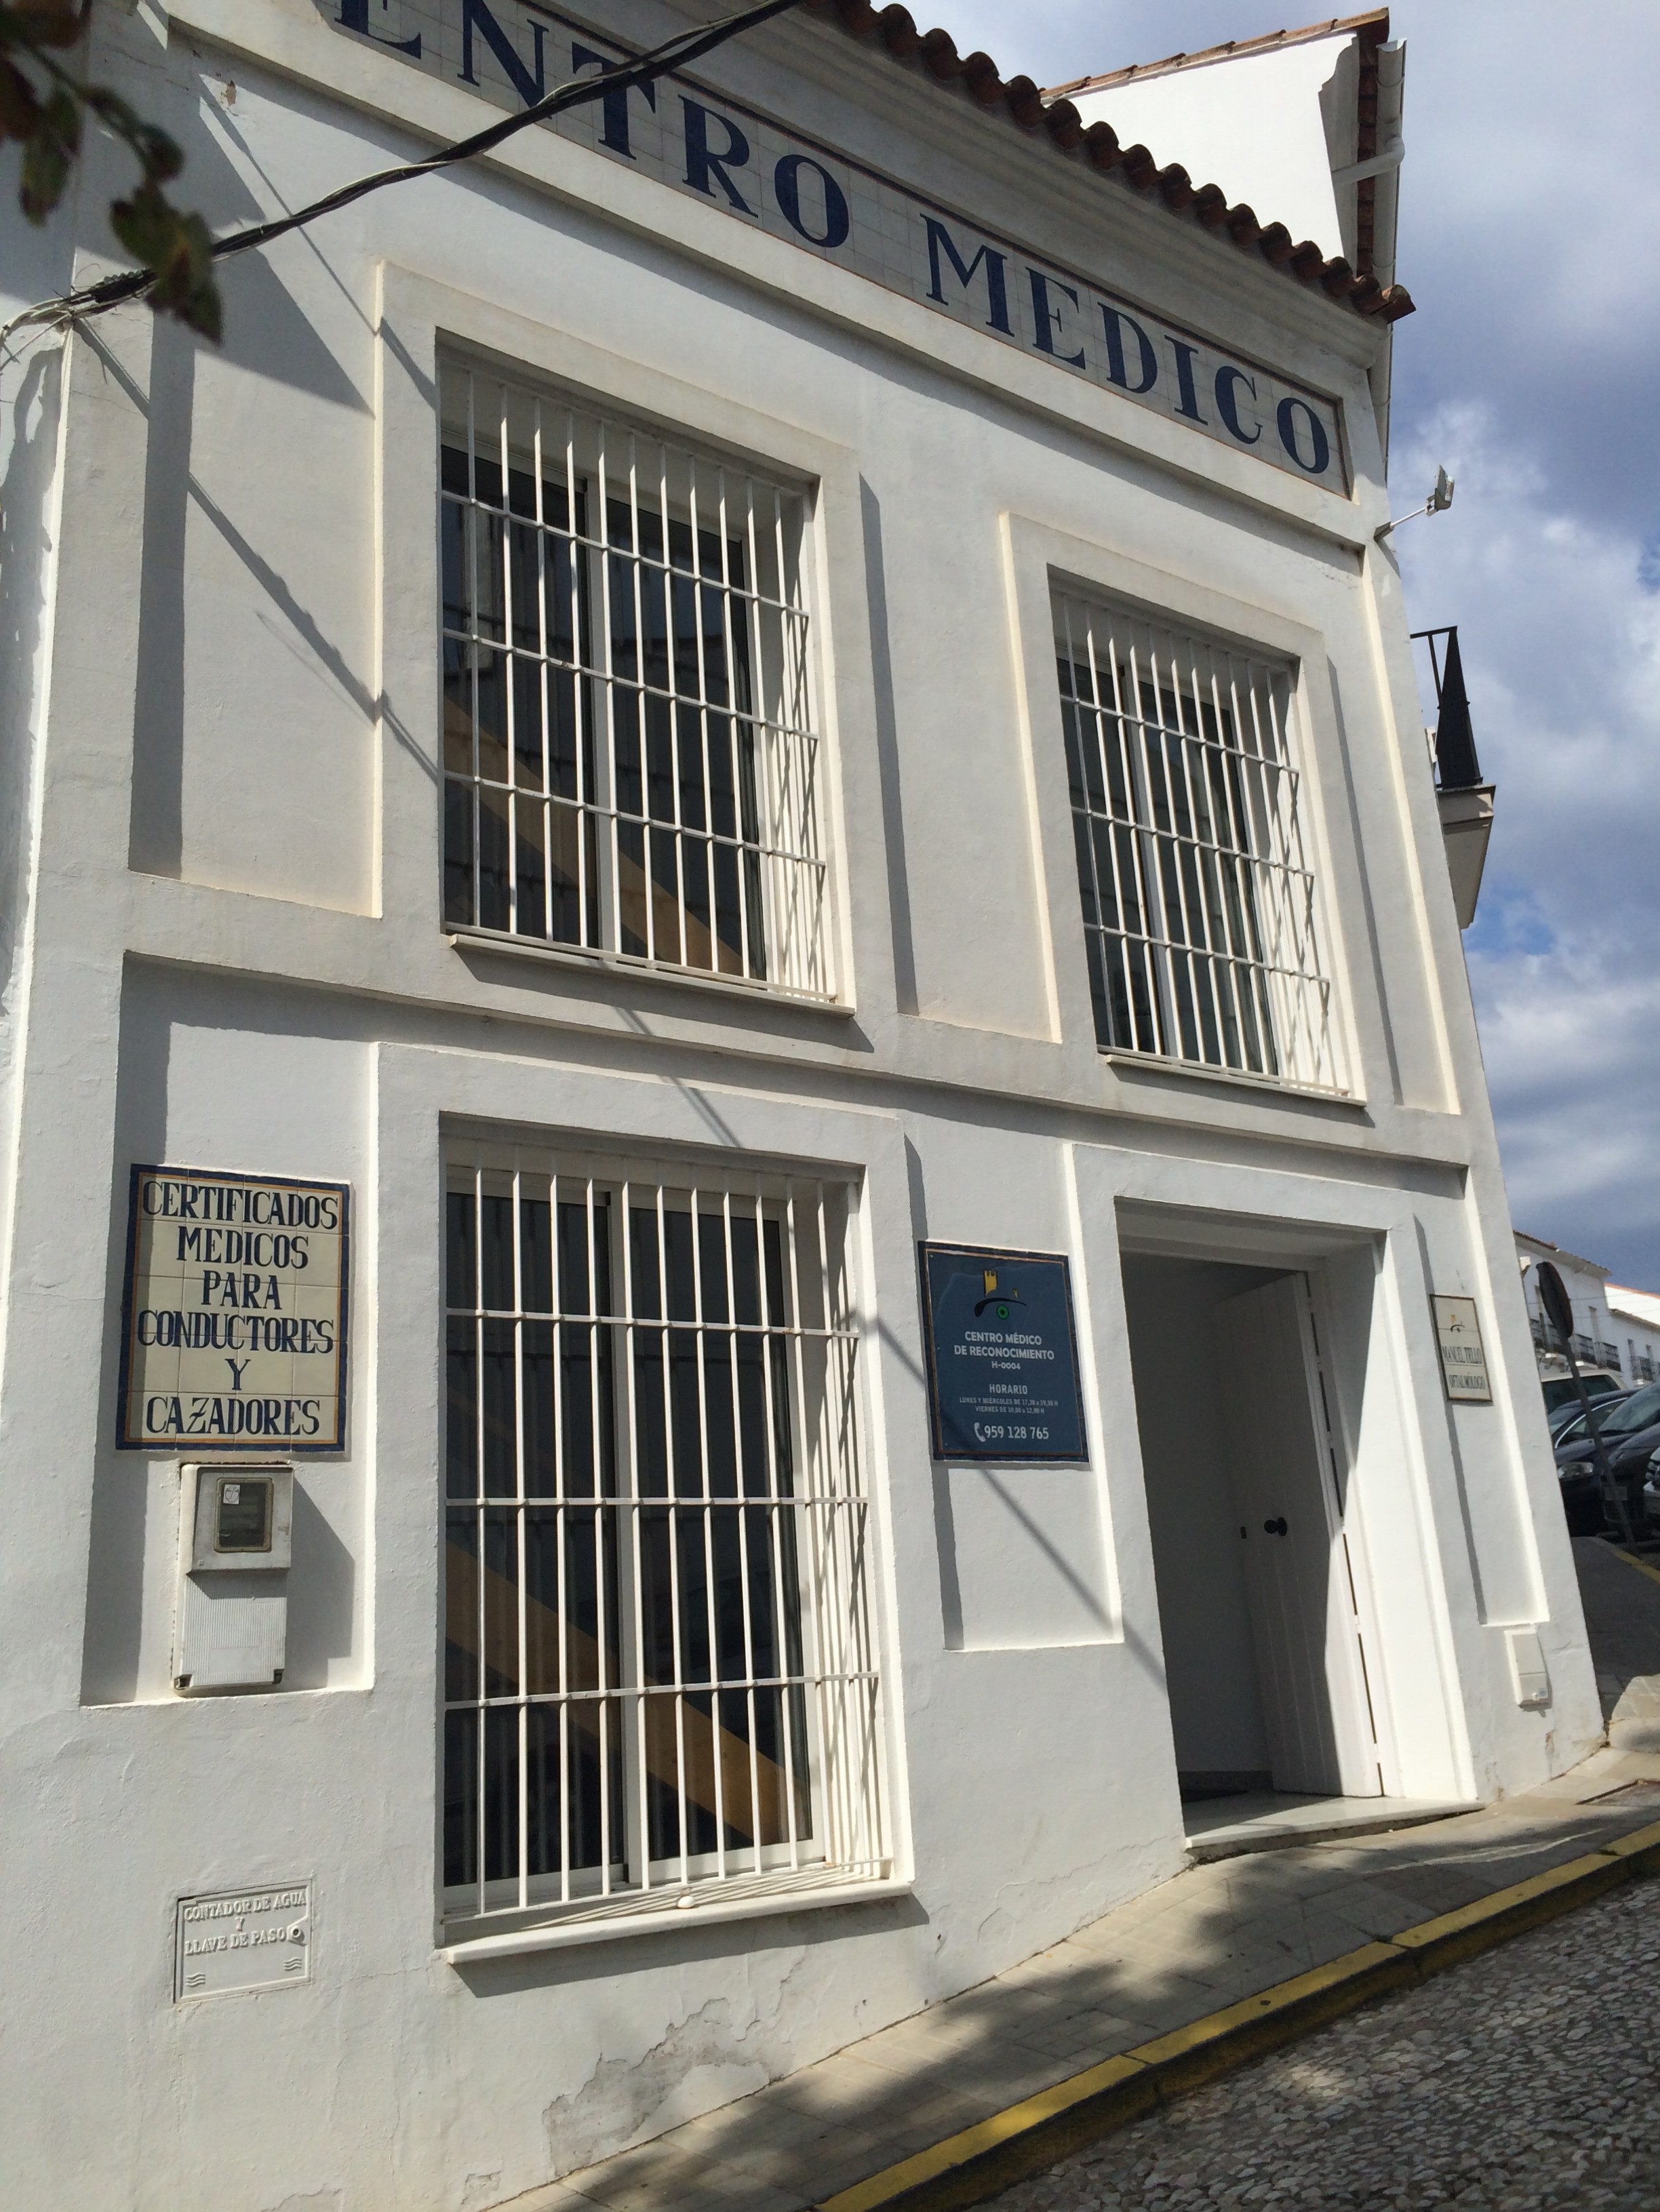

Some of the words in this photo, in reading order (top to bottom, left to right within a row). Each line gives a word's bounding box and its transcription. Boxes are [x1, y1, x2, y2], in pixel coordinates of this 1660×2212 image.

[919, 212, 1330, 474] MEDICO
[142, 1180, 338, 1230] CERTIFICADOS
[176, 1226, 309, 1269] MEDICOS
[201, 1270, 283, 1310] PARA
[138, 1310, 334, 1354] CONDUCTORES
[964, 1331, 1004, 1343] CENTRO
[1005, 1332, 1042, 1346] MÉDICO
[953, 1344, 967, 1355] DE
[969, 1346, 1055, 1360] RECONOCIMIENTO
[991, 1361, 1021, 1370] H-0004
[224, 1359, 251, 1390] Y
[989, 1384, 1028, 1394] HORARIO
[146, 1396, 321, 1436] CAZADORES
[984, 1425, 1004, 1439] 959
[1007, 1426, 1027, 1439] 128
[1029, 1426, 1050, 1440] 765
[184, 1900, 252, 1923] CONTADOR
[252, 1896, 271, 1913] DE
[273, 1891, 308, 1910] AGUA
[235, 1916, 245, 1931] Y
[184, 1935, 228, 1956] LLAVE
[230, 1932, 248, 1949] DE
[251, 1927, 288, 1946] PASO
